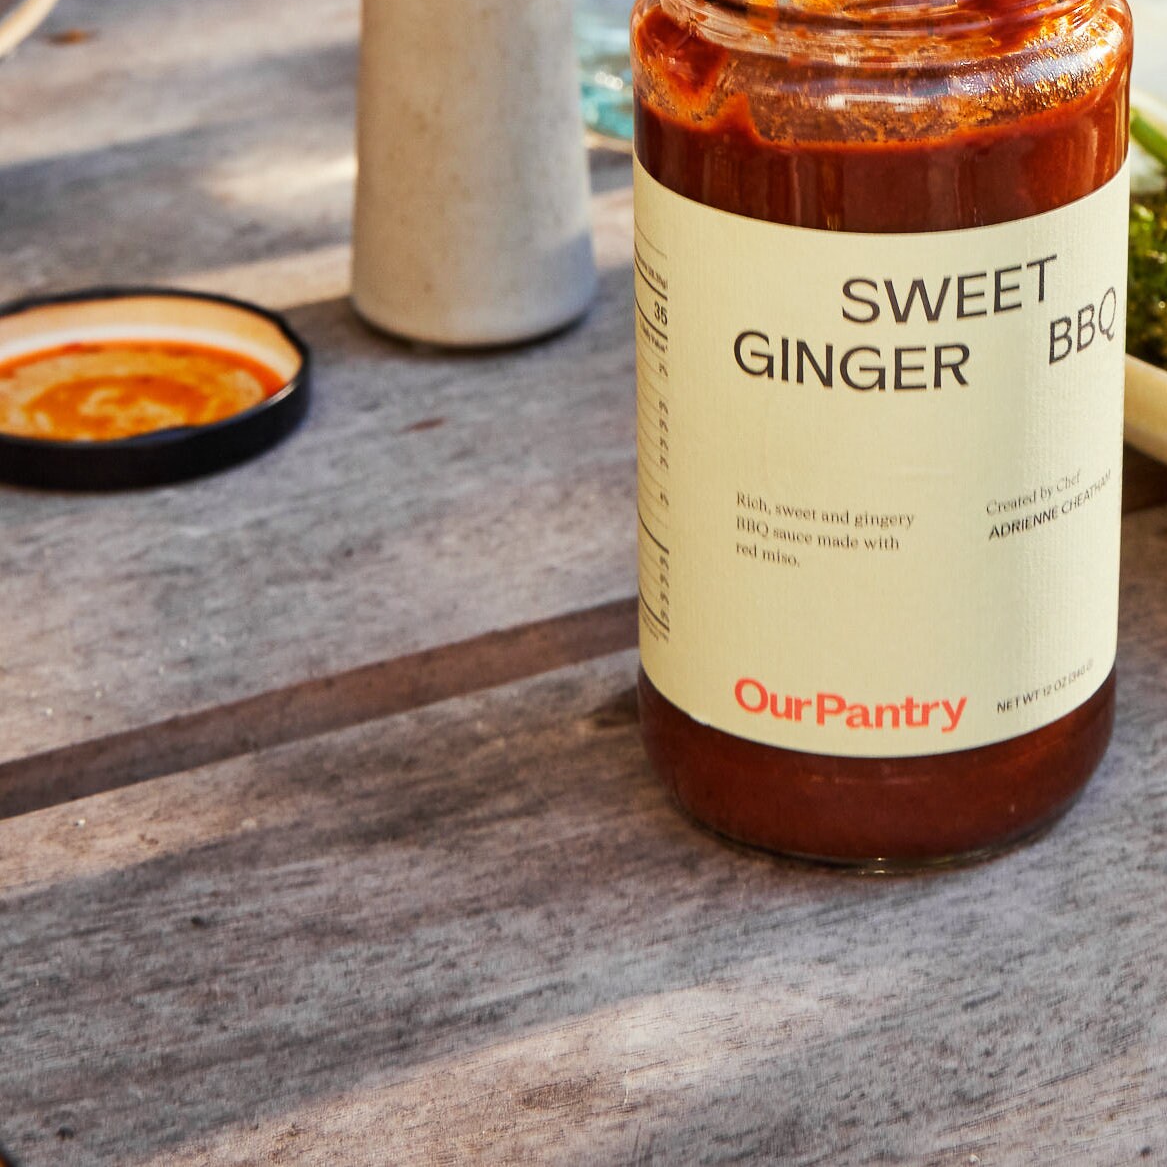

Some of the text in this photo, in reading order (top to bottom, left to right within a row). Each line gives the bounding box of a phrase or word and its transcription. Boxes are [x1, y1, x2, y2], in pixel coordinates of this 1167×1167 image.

[841, 253, 1058, 324] SWEET
[733, 329, 971, 392] GINGER
[1048, 286, 1117, 366] BBQ
[736, 490, 915, 530] Rich, sweet and gingery
[986, 468, 1082, 515] Created by Chef
[989, 467, 1112, 540] ADRIENNE CHEATHAM
[736, 515, 900, 551] BBQ sauce made with
[736, 541, 800, 568] red miso.
[996, 696, 1020, 714] NET
[1022, 690, 1040, 706] WT
[1043, 683, 1053, 697] 12
[1054, 675, 1067, 692] OZ
